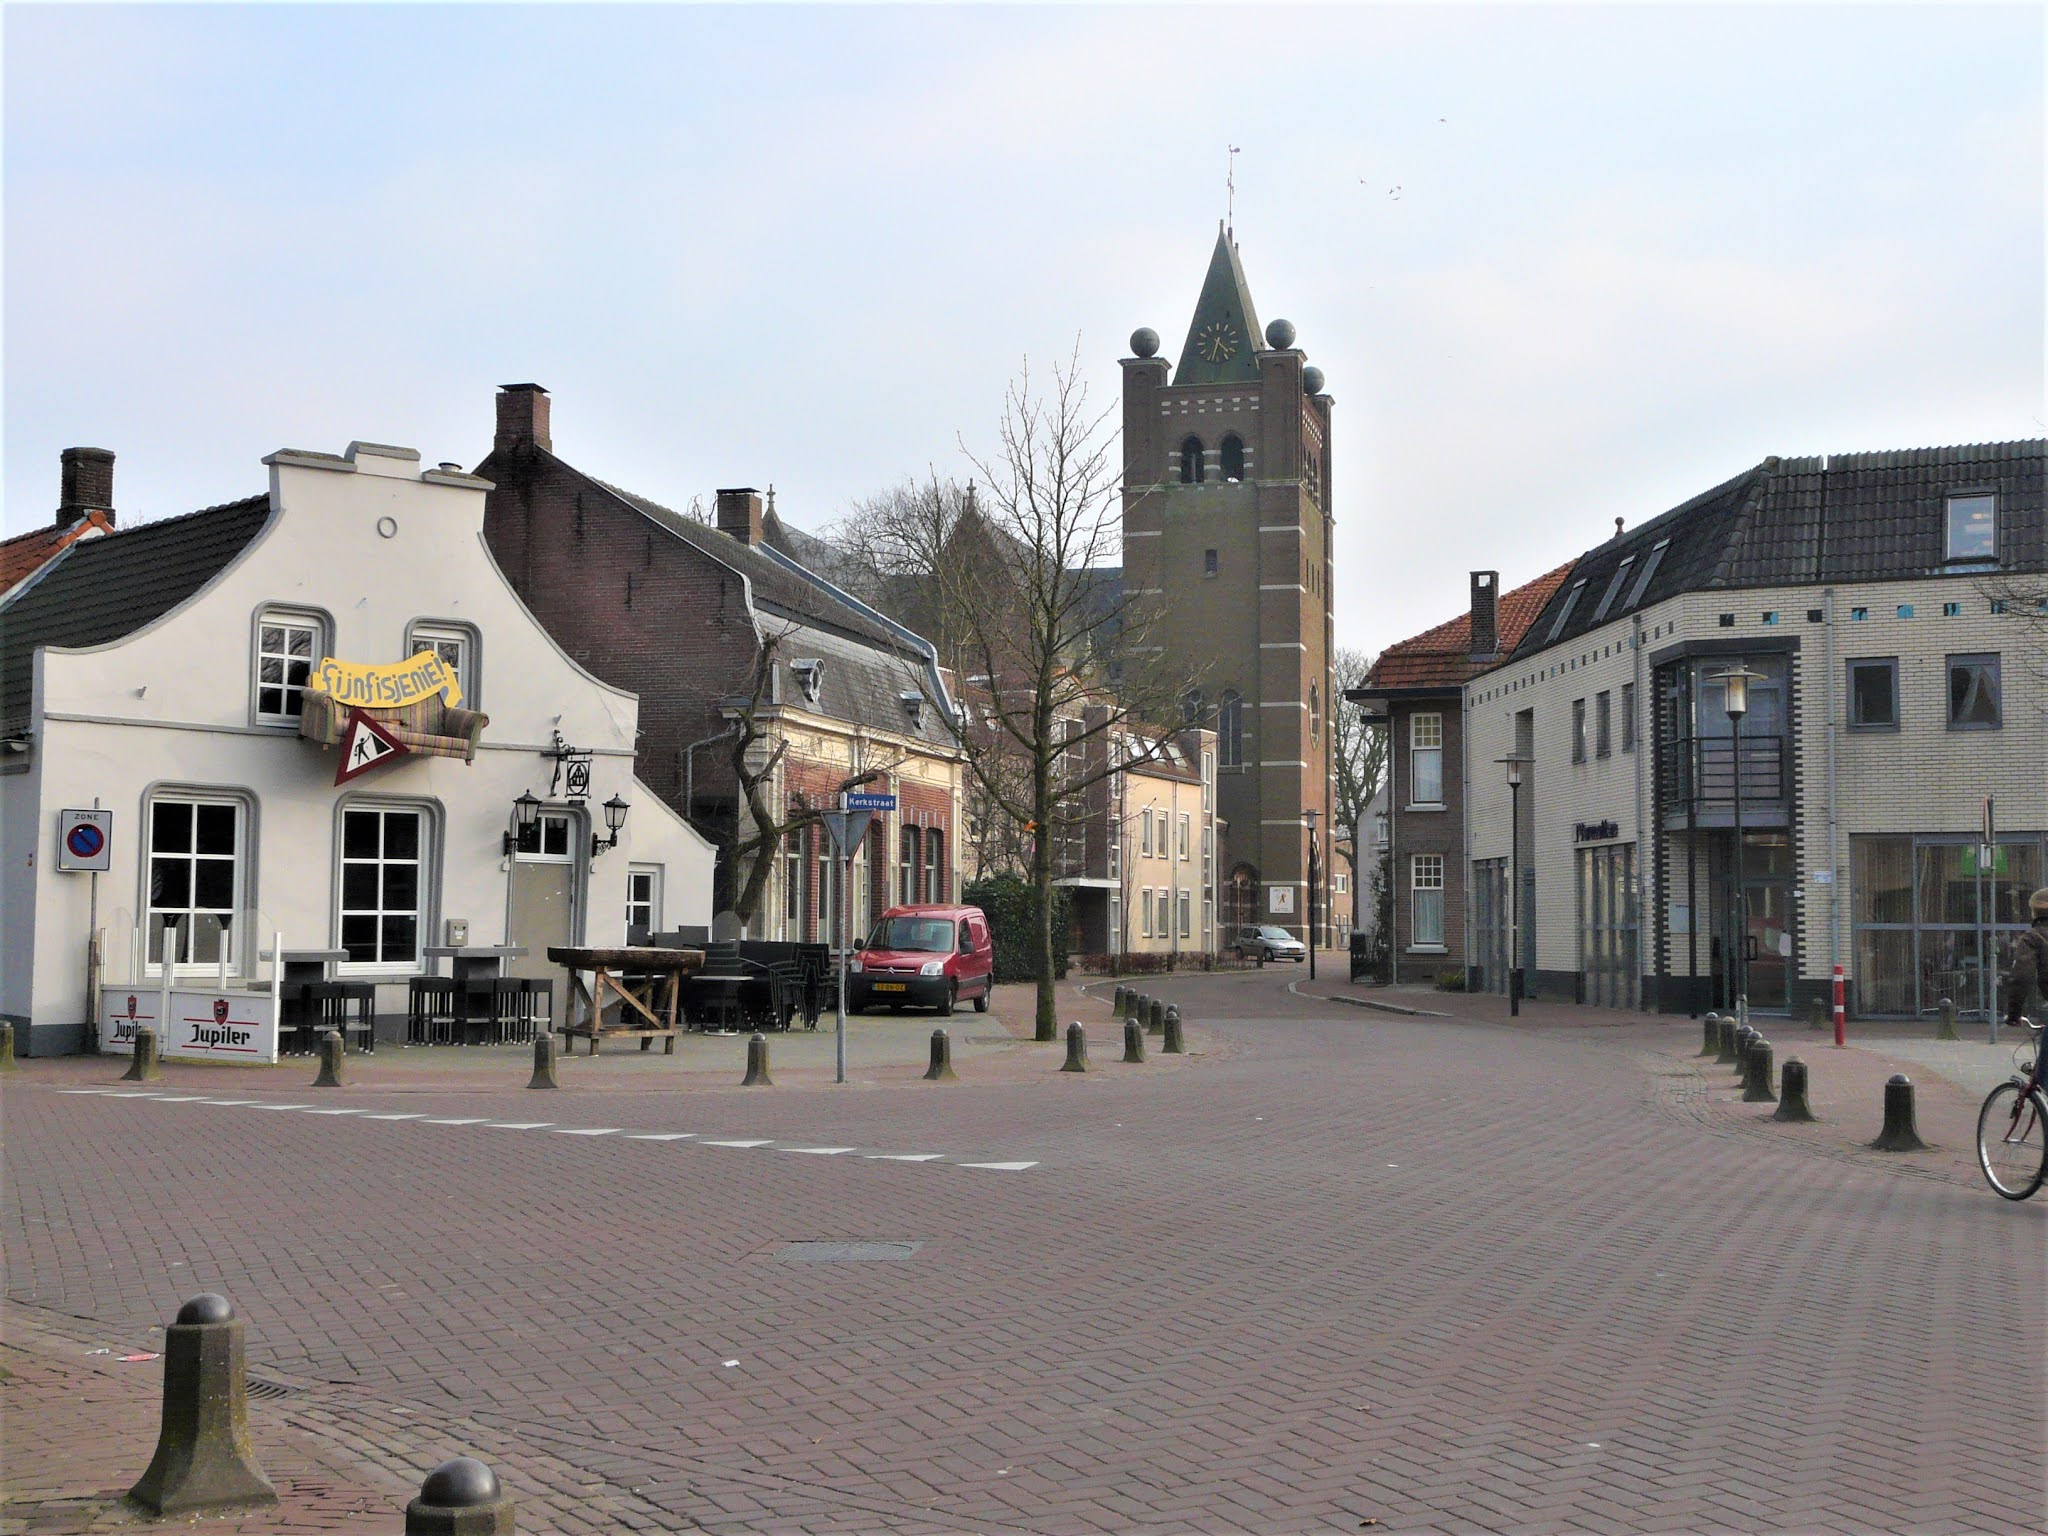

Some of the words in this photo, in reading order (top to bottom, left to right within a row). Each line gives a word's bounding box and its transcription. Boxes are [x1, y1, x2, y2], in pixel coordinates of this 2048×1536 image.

[849, 797, 894, 807] Kerkstraat
[74, 813, 99, 821] ZONE
[113, 1020, 142, 1042] Jupil
[190, 1024, 250, 1048] Jupiler
